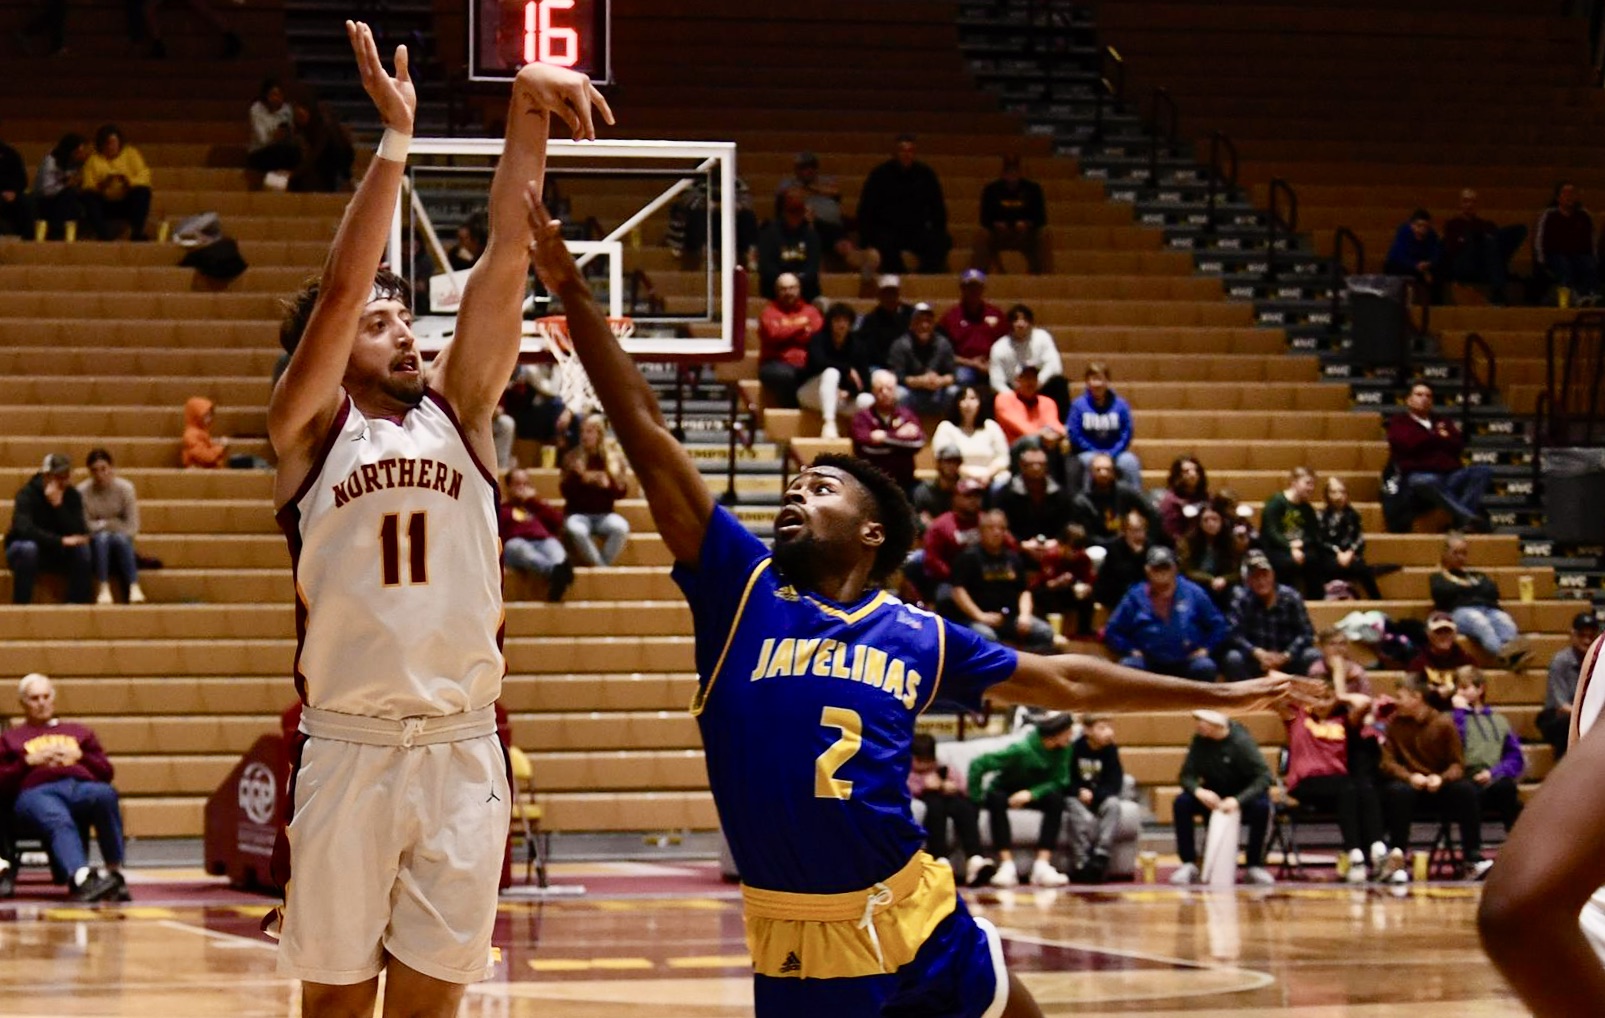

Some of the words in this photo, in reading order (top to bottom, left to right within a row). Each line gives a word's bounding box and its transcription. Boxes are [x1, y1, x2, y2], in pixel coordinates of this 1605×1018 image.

[524, 0, 578, 66] 16
[332, 458, 463, 508] NORTHERN
[379, 510, 428, 588] 11
[750, 638, 922, 710] JAVELINAS
[814, 705, 863, 800] 2
